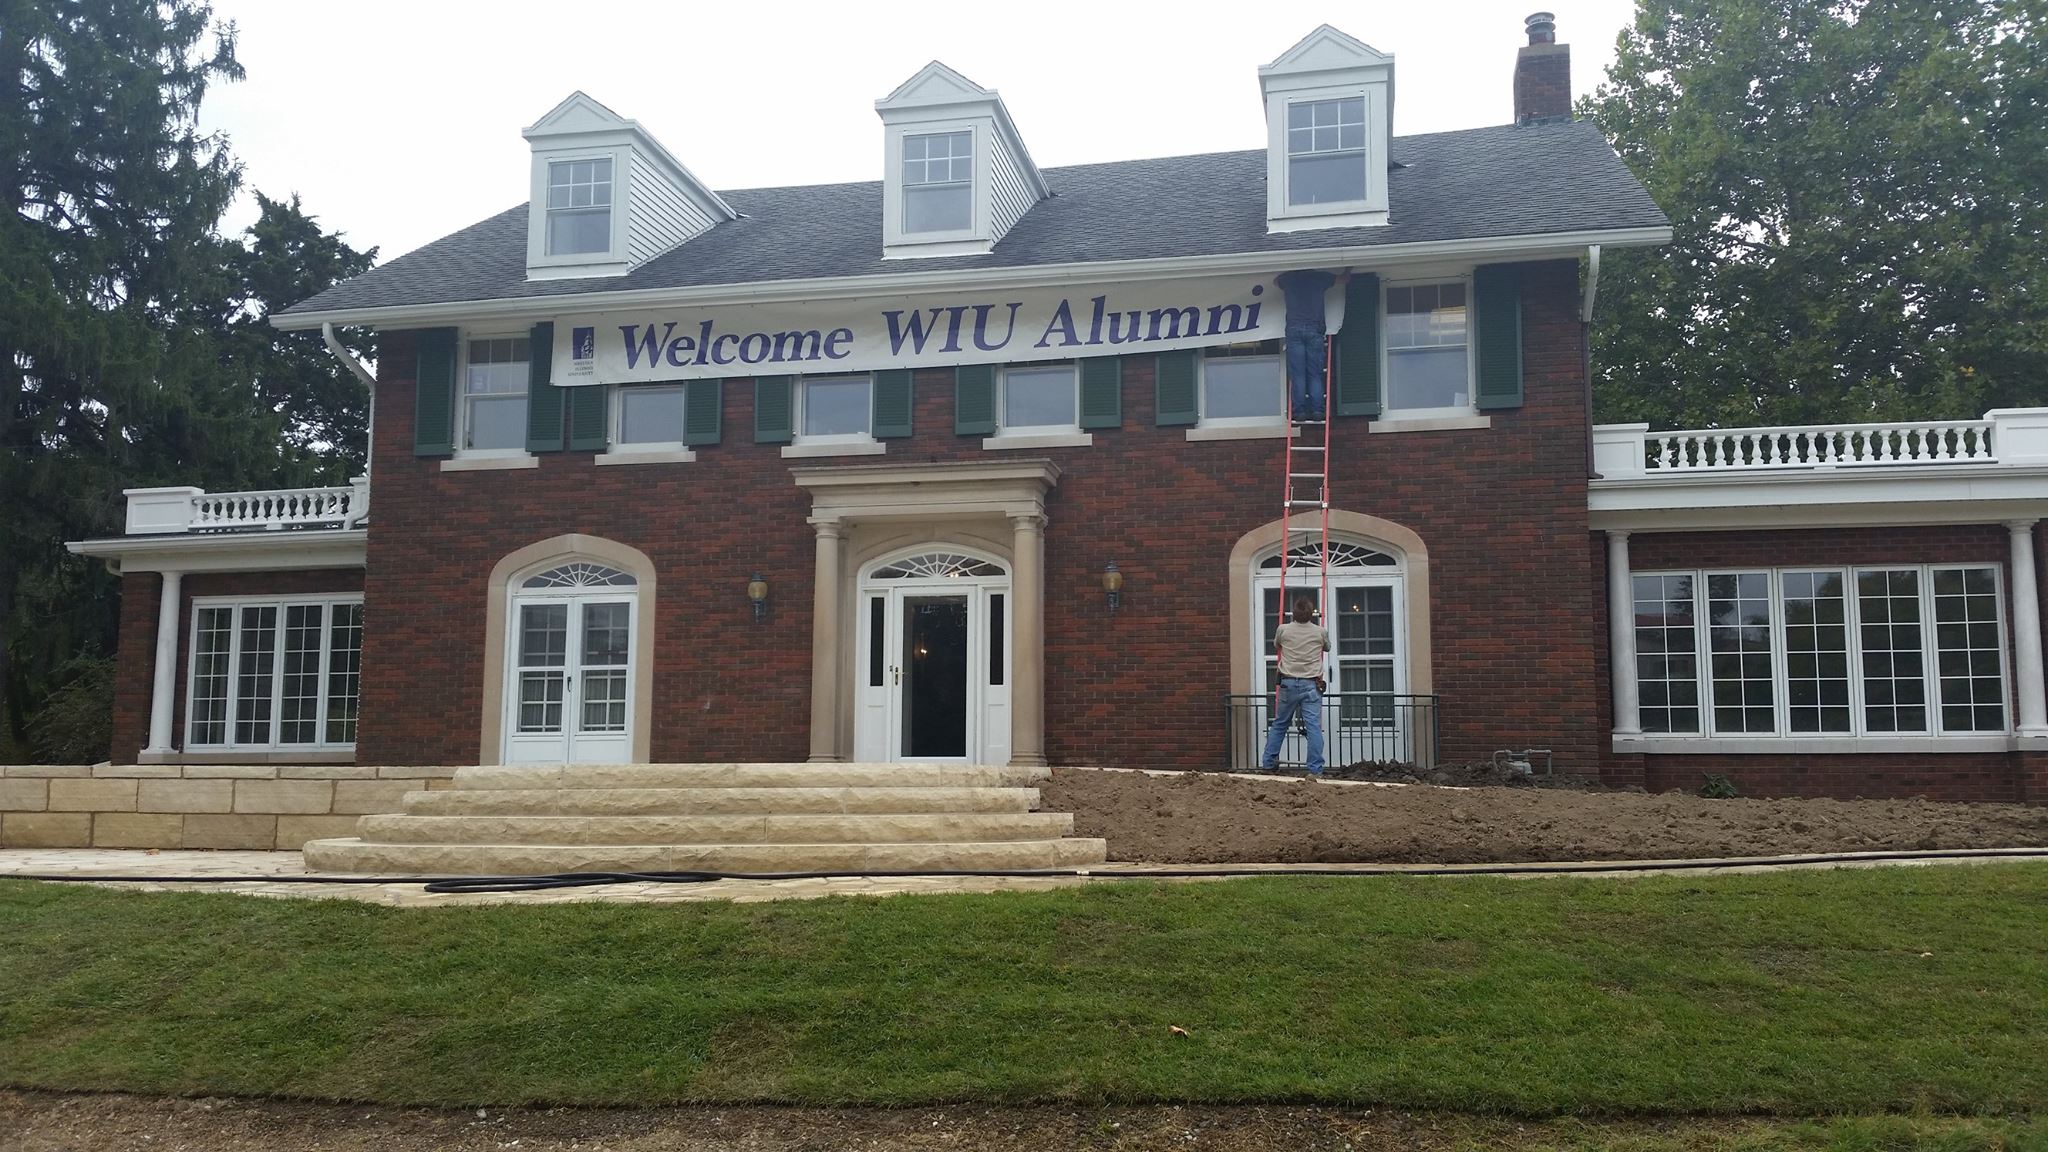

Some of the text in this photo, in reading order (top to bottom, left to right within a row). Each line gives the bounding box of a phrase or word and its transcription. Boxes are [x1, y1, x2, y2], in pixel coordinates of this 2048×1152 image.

[618, 285, 1263, 369] Welcome WIU Alumni
